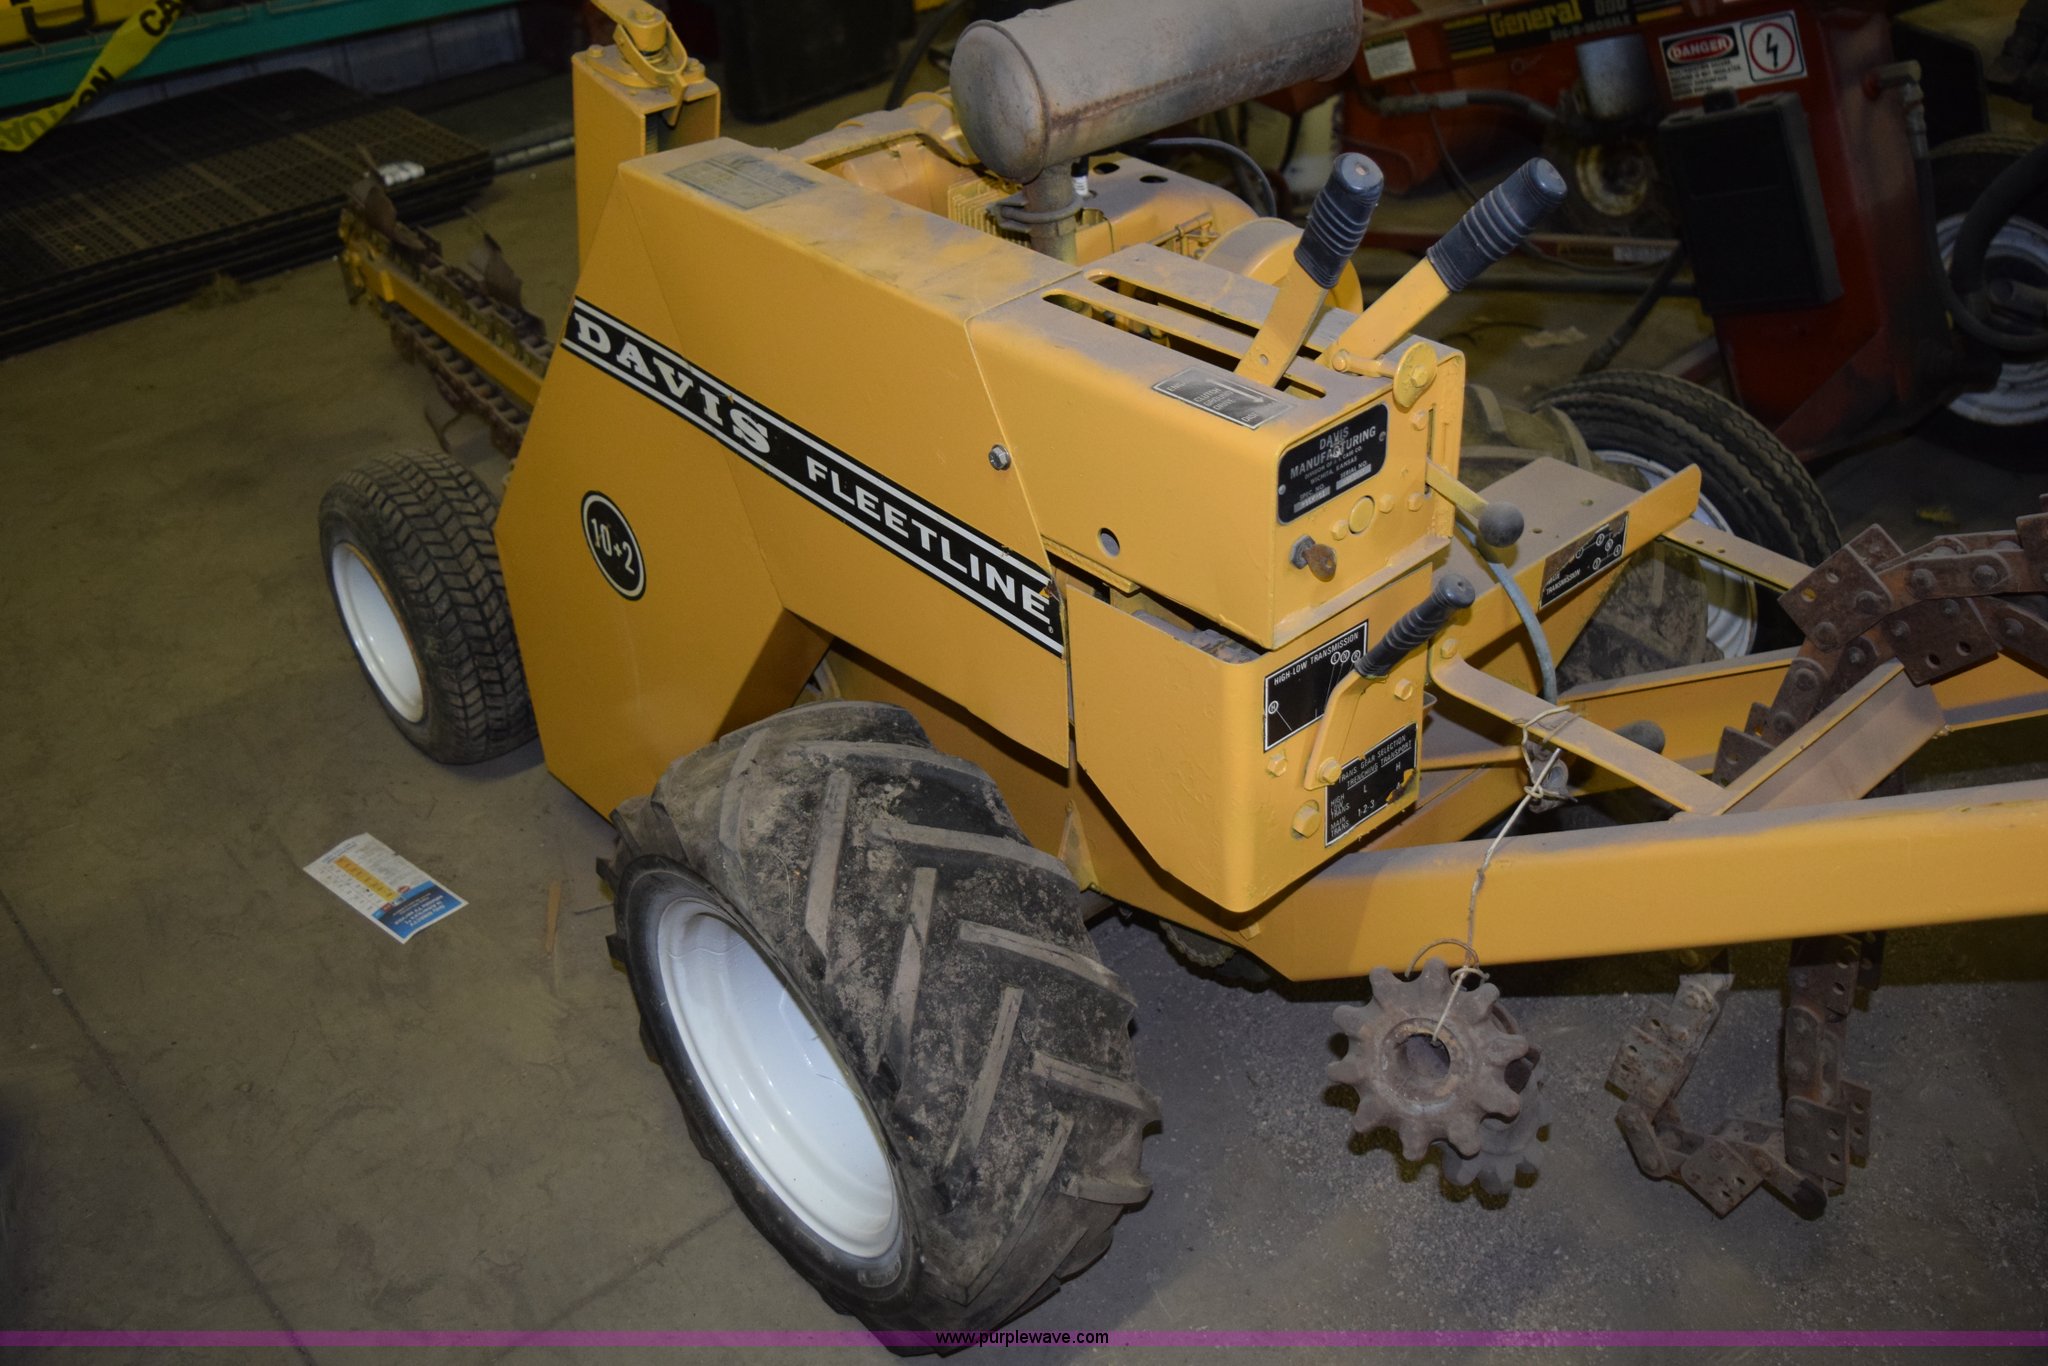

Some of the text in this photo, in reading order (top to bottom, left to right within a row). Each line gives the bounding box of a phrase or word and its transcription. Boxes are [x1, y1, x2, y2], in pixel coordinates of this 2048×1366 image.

[1489, 0, 1583, 39] General
[1673, 37, 1729, 59] DANGER
[1290, 426, 1377, 479] MANUFACTURING
[1319, 426, 1350, 450] DAVIS
[573, 311, 1052, 626] DAVIS FLEETLINE
[1273, 632, 1359, 686] HIGH-LOW TRANSMISSION
[1347, 739, 1412, 787] TRENCHING TRANSPORT
[1377, 736, 1406, 758] SELECTION
